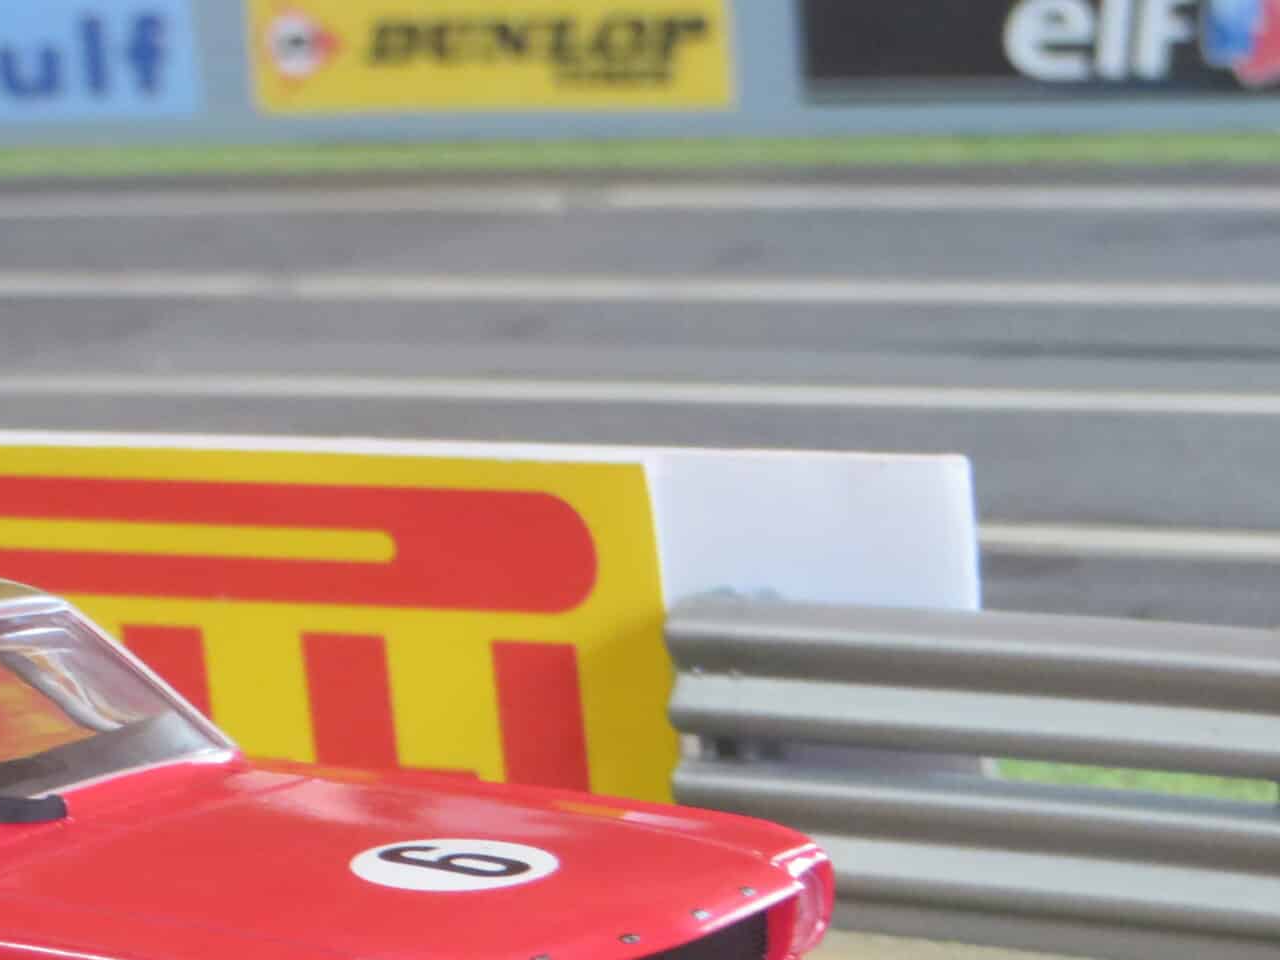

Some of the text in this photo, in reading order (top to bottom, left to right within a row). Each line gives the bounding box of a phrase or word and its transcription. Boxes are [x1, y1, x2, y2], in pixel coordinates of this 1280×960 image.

[368, 15, 709, 66] DUNLOP
[1003, 0, 1192, 80] elf
[377, 845, 532, 878] 6
